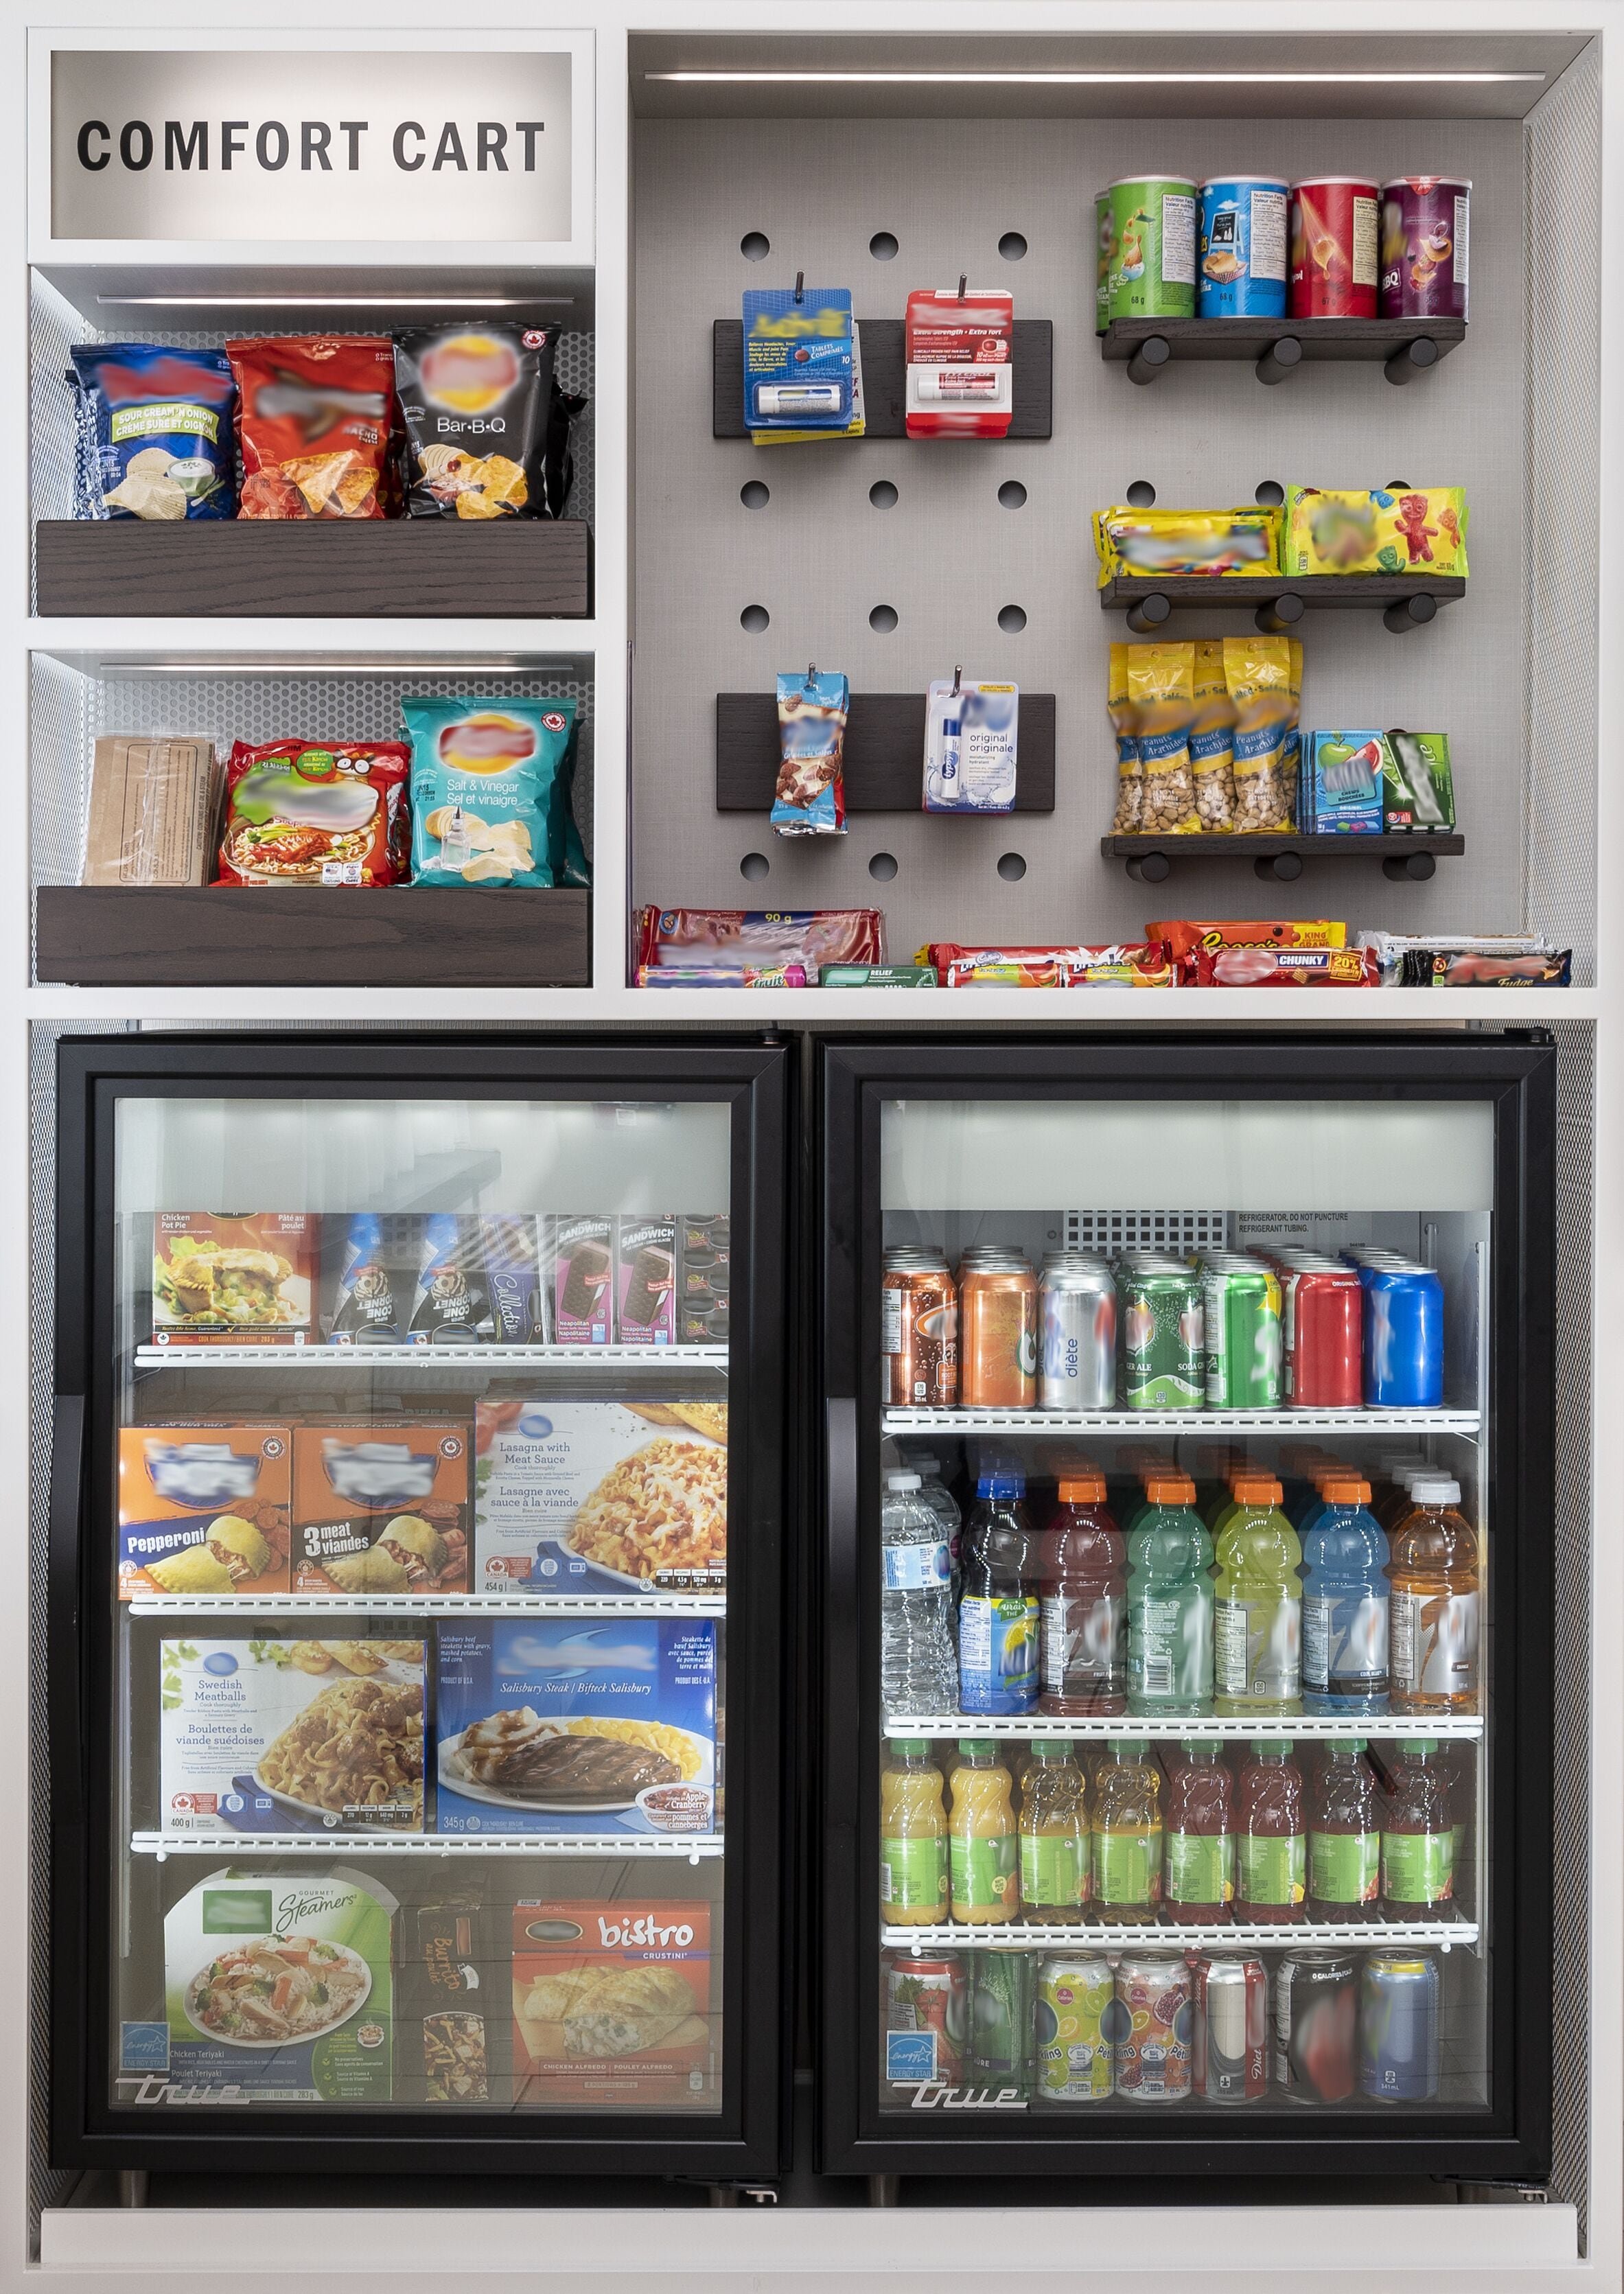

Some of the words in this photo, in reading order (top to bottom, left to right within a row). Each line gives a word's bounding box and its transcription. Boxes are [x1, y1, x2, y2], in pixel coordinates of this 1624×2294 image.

[77, 119, 369, 172] COMFORT
[393, 121, 546, 172] CART
[842, 356, 850, 364] 10
[119, 409, 142, 424] SOUR
[144, 407, 175, 417] CREAM
[187, 408, 213, 424] ONION
[116, 420, 146, 437] CRÈME
[172, 419, 182, 428] ET
[184, 420, 213, 437] OIGNON
[970, 733, 1008, 743] original
[1236, 730, 1270, 744] Peanuts
[969, 743, 1014, 754] originale
[1148, 736, 1187, 755] Arachides
[447, 779, 467, 791] Salt
[469, 780, 477, 791] &
[480, 780, 519, 794] Vinegar
[447, 793, 463, 804] Sel
[466, 794, 475, 804] et
[478, 794, 518, 808] vinaigre
[765, 913, 780, 923] 90
[785, 915, 792, 925] g
[1304, 931, 1326, 940] KING
[1279, 955, 1324, 966] CHUNKY
[1334, 955, 1358, 970] 20%
[752, 975, 783, 988] fruit
[1498, 977, 1533, 987] Fudge
[1239, 1214, 1288, 1222] REFRIGERATOR.
[1301, 1213, 1313, 1221] NOT
[281, 1222, 305, 1230] poulet
[1239, 1225, 1283, 1233] REFRIGERANT
[558, 1223, 611, 1243] SANDWICH
[621, 1228, 675, 1248] SANDWICH
[356, 1293, 393, 1310] CORNET
[433, 1293, 471, 1310] CORNET
[494, 1273, 522, 1339] Collection
[367, 1306, 393, 1319] CONE
[443, 1304, 470, 1319] CONE
[1065, 1339, 1078, 1378] diète
[500, 1442, 544, 1454] Lasagna
[546, 1441, 570, 1452] with
[504, 1454, 531, 1464] Meat
[534, 1454, 566, 1464] Sauce
[500, 1486, 544, 1498] Lasagne
[522, 1497, 529, 1507] à
[531, 1496, 541, 1507] la
[543, 1496, 579, 1507] viande
[128, 1527, 205, 1554] Pepperoni
[303, 1526, 321, 1557] 3
[321, 1522, 351, 1539] meat
[322, 1536, 369, 1555] viandes
[119, 1578, 128, 1588] 4
[297, 1577, 304, 1587] 4
[485, 1582, 497, 1592] 454
[498, 1584, 503, 1593] g
[198, 1679, 242, 1689] Swedish
[500, 1683, 542, 1695] Salisbury
[545, 1683, 570, 1693] Steak
[577, 1683, 607, 1693] Bifteck
[609, 1683, 651, 1695] Salisbury
[194, 1691, 246, 1701] Meatballs
[188, 1724, 237, 1734] Boulettes
[240, 1724, 253, 1734] de
[176, 1735, 211, 1745] viande
[213, 1735, 265, 1745] suédoises
[686, 1792, 708, 1802] Apple-
[171, 1818, 184, 1828] 400
[185, 1820, 190, 1830] g
[443, 1816, 458, 1829] 345
[459, 1819, 465, 1831] g
[668, 1822, 708, 1830] canneberges
[276, 1894, 353, 1932] Steamers
[598, 1914, 695, 1948] bistro
[434, 1938, 461, 1990] Burrito
[170, 2050, 196, 2059] Chicken
[198, 2050, 224, 2059] Teriyaki
[124, 2059, 146, 2067] ENERGY
[148, 2059, 165, 2067] STAR
[1251, 2048, 1263, 2080] Diet
[195, 2070, 222, 2078] Teriyaki
[115, 2074, 252, 2105] true
[892, 2079, 1028, 2108] true
[310, 2092, 314, 2100] g
